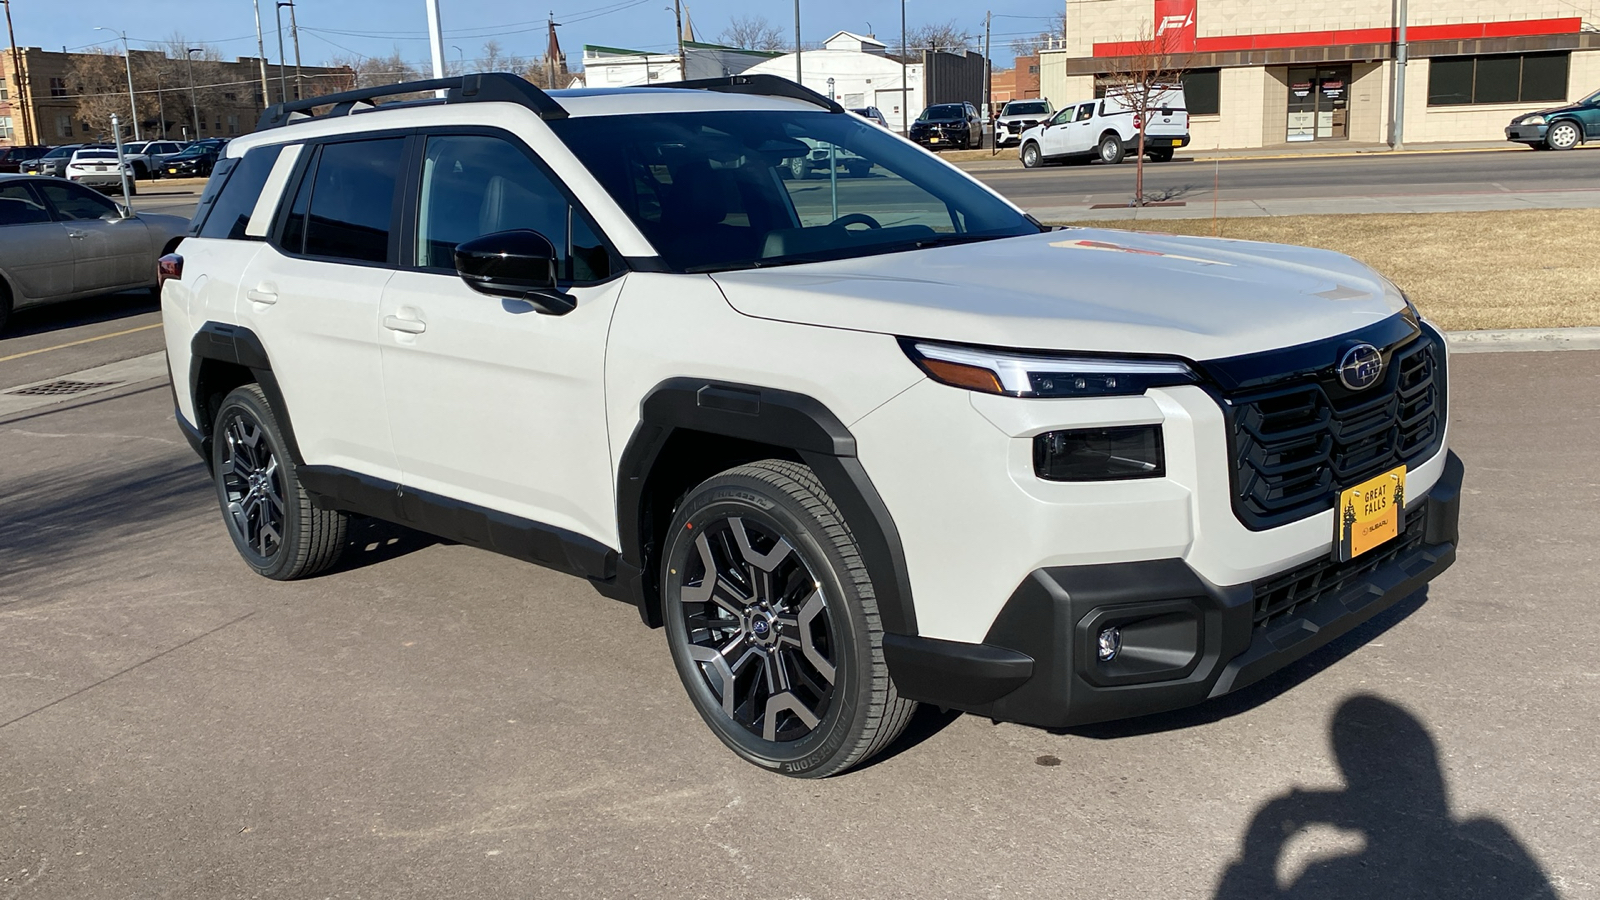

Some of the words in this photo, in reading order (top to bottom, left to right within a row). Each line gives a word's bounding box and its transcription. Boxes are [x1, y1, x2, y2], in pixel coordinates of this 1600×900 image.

[1364, 484, 1386, 503] GREAT
[1364, 497, 1386, 516] FALLS
[1369, 519, 1388, 533] SUBARU
